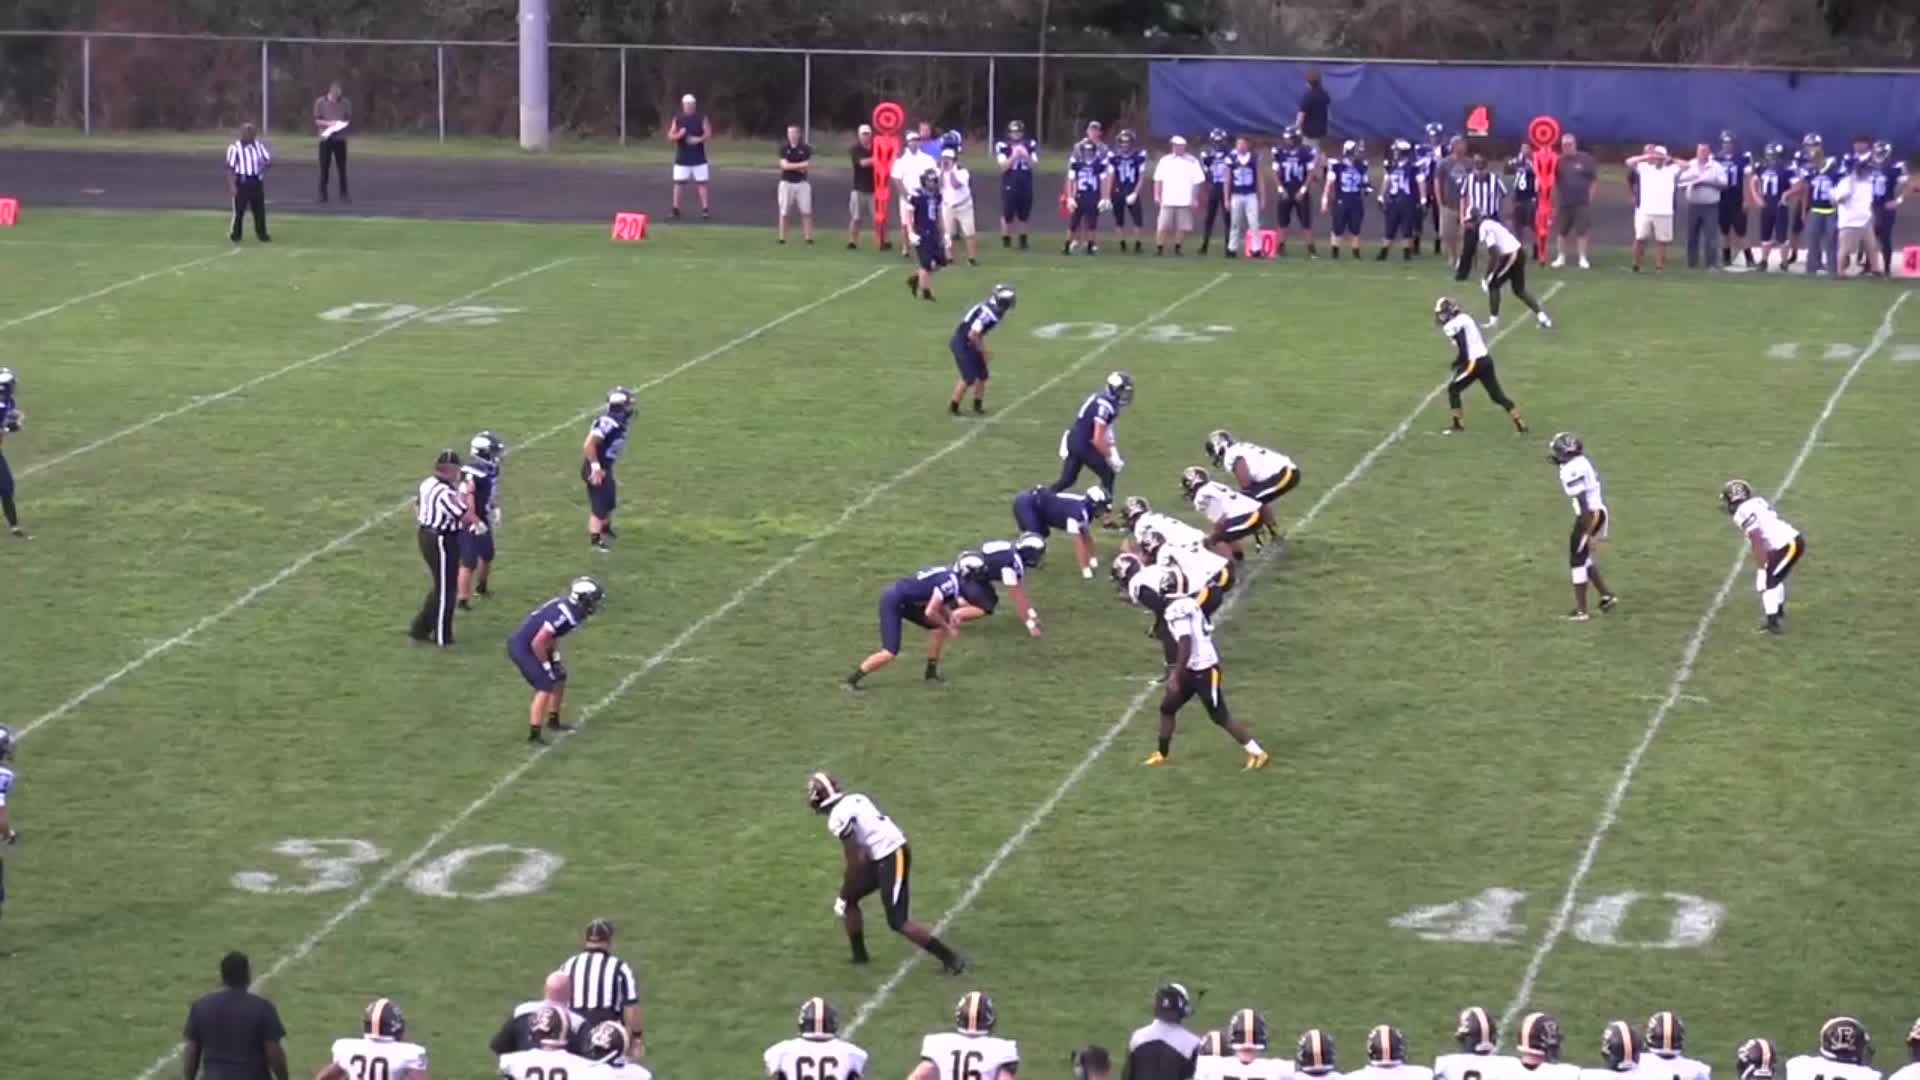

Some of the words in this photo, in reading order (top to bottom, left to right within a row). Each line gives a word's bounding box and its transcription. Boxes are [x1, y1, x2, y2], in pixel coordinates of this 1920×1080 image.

[1467, 106, 1489, 132] 4
[616, 217, 639, 239] 20
[230, 837, 565, 899] 30
[1387, 886, 1726, 949] 40
